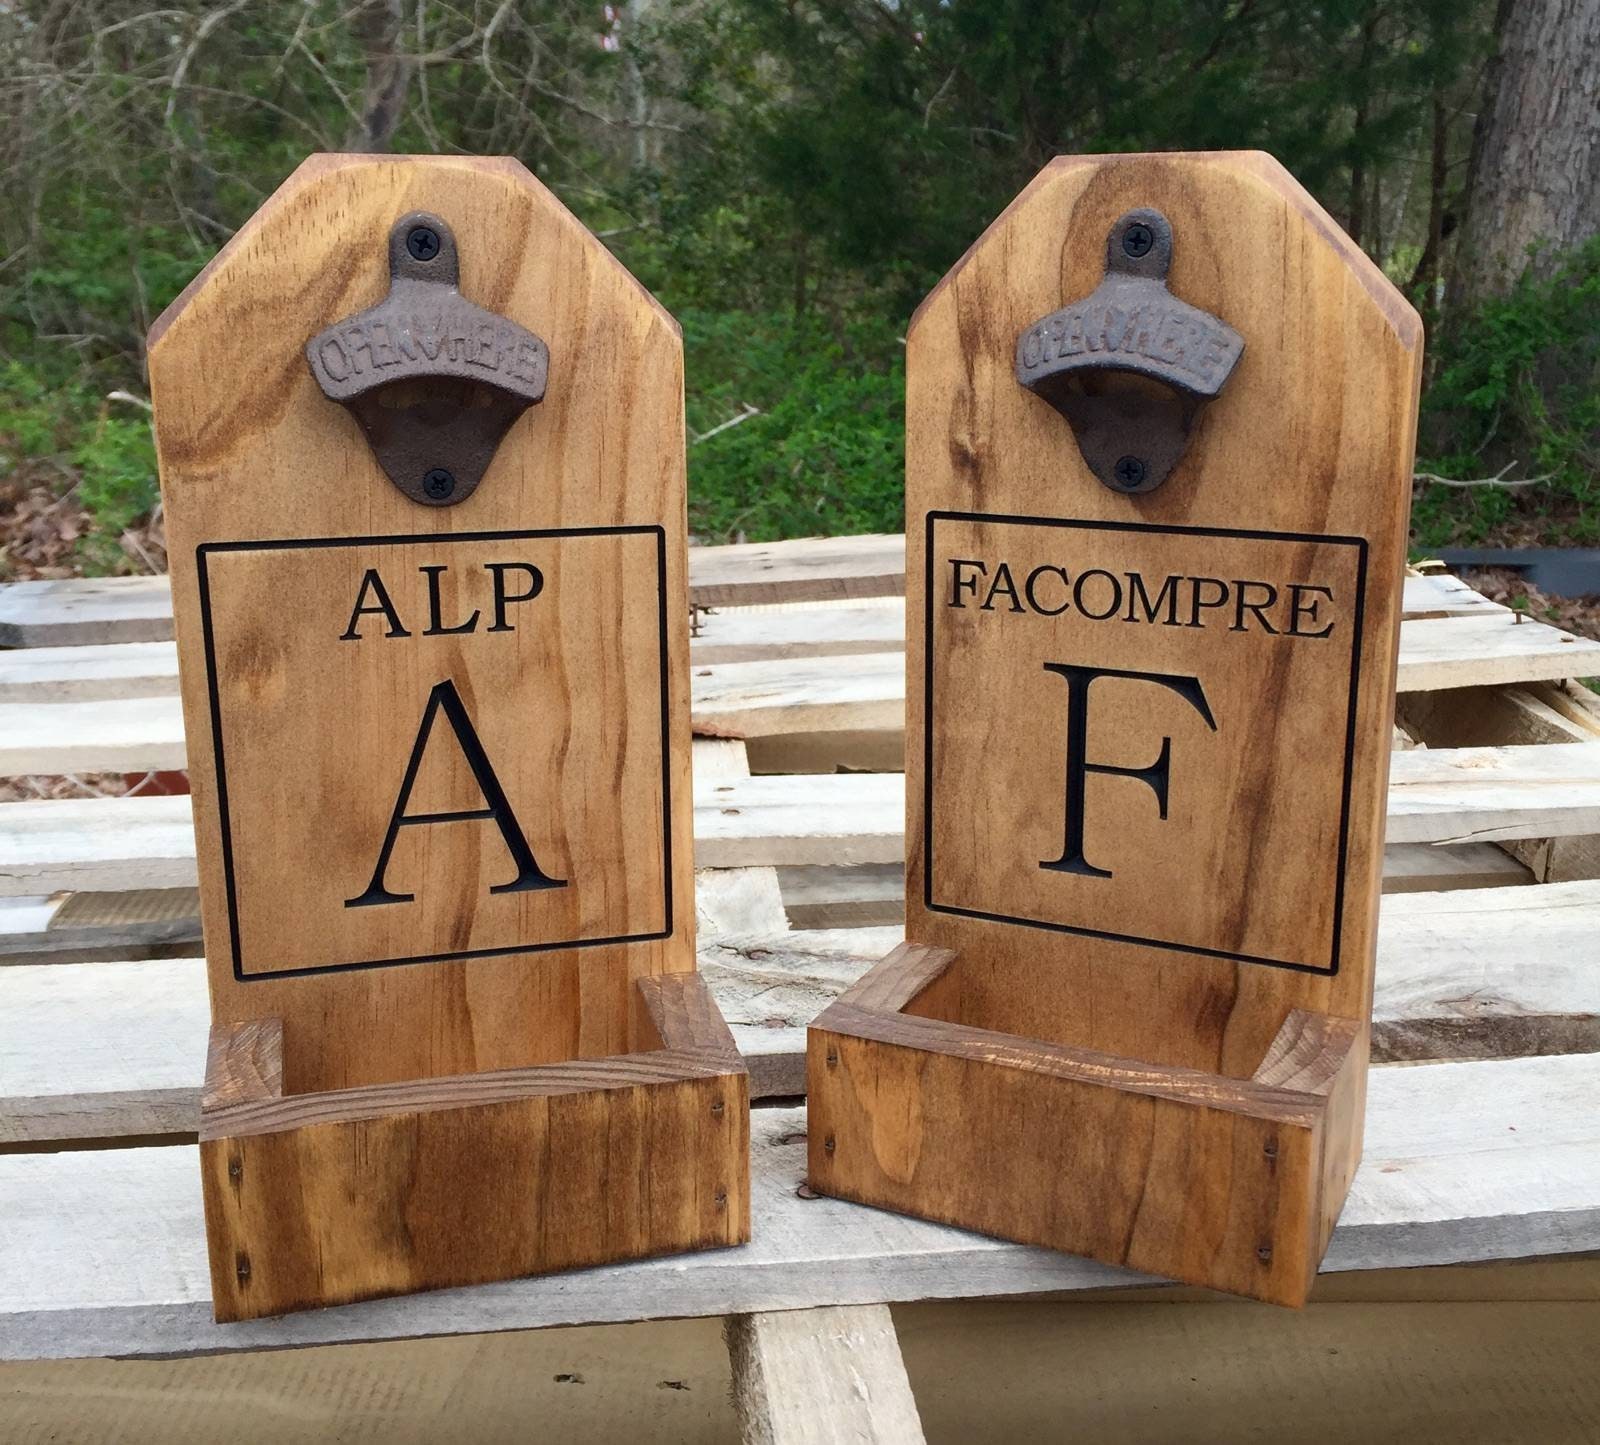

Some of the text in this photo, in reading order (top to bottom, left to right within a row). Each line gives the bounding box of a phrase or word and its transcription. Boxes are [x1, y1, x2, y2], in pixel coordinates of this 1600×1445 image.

[339, 562, 544, 640] ALP
[947, 559, 1336, 639] FACOMPRE
[344, 678, 568, 908] A
[1039, 662, 1218, 879] F
